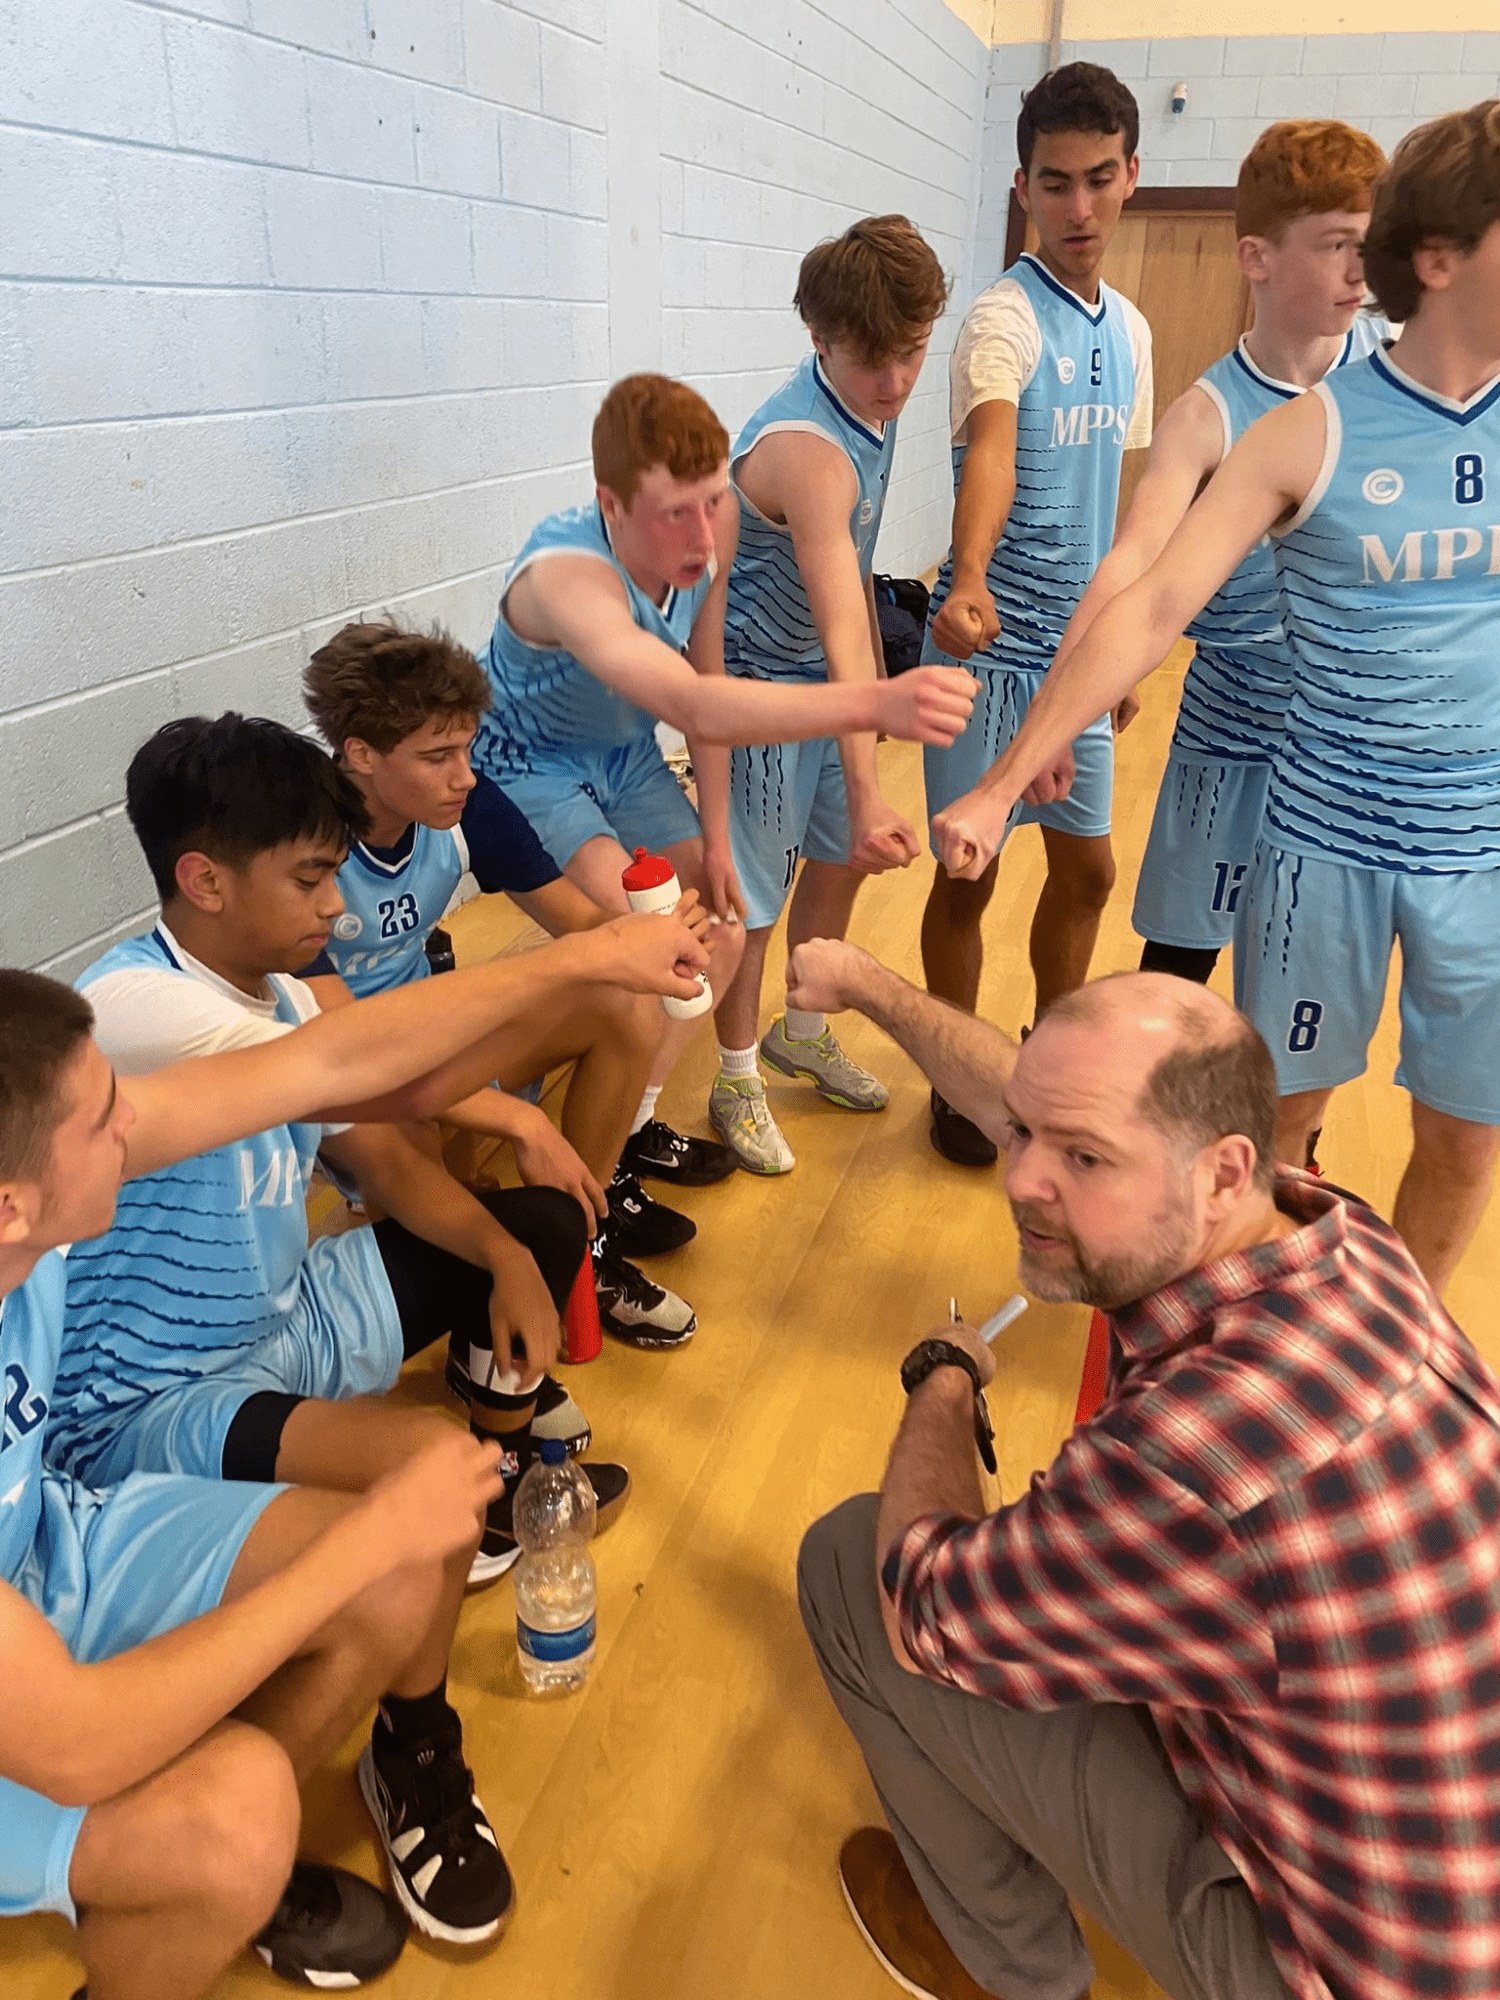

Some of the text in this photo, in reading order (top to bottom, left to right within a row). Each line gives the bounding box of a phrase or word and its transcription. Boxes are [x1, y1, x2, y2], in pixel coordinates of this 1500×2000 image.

[1090, 348, 1102, 387] 9
[1048, 404, 1128, 448] MPPS
[1454, 453, 1484, 505] 8
[377, 892, 420, 940] 23
[1287, 999, 1324, 1054] 8
[0, 1363, 48, 1453] 2
